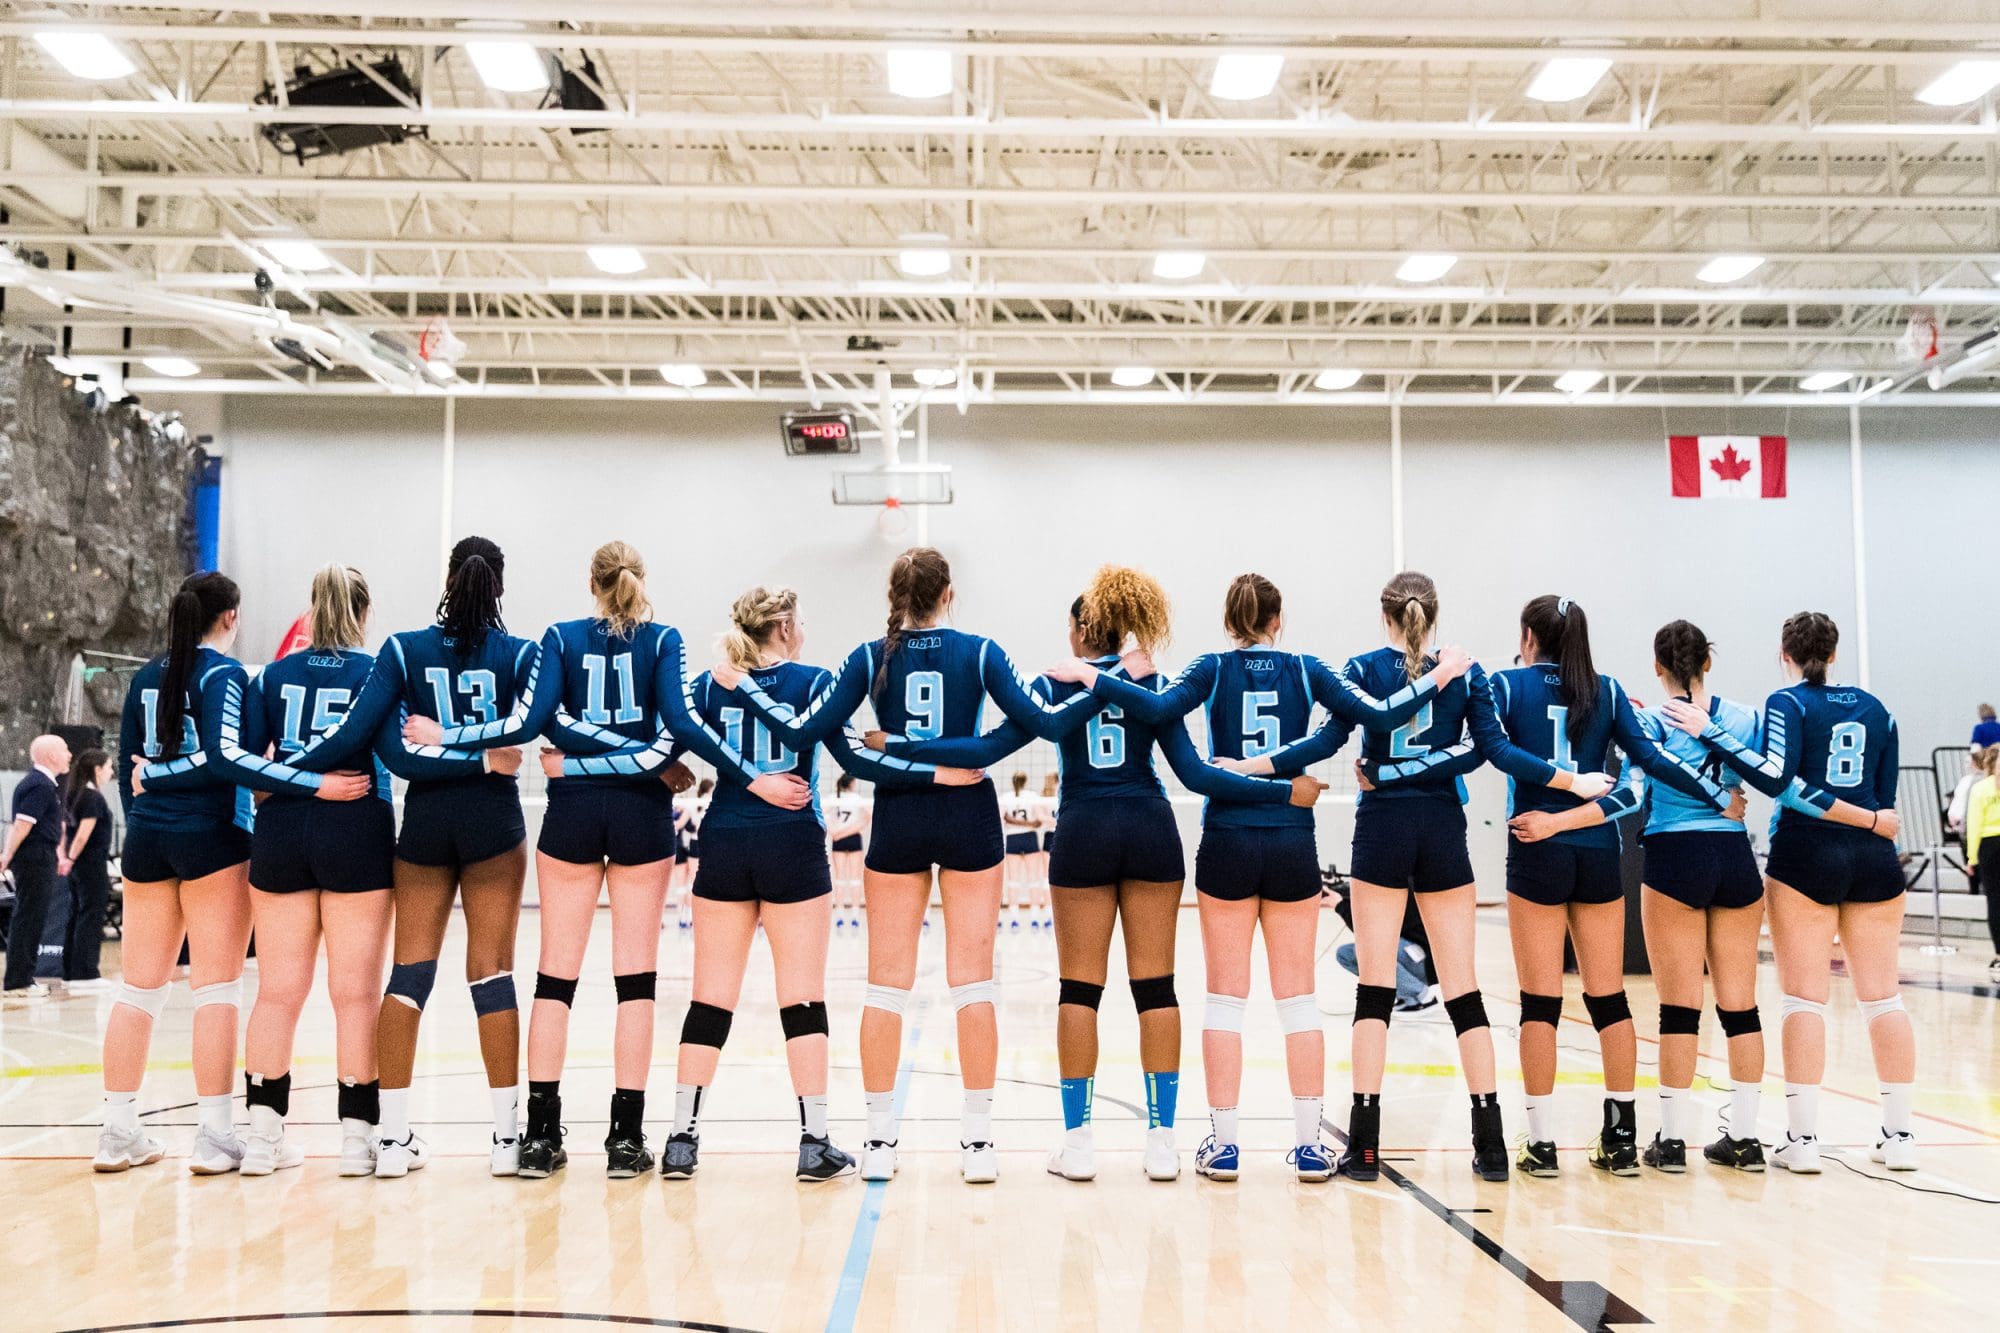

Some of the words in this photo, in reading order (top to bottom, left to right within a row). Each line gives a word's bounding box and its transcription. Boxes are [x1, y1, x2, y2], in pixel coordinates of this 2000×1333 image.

[801, 423, 846, 439] 4:00
[308, 656, 349, 669] OCAA
[582, 652, 643, 725] 11
[280, 683, 352, 754] 15
[425, 666, 498, 727] 13
[904, 671, 945, 741] 9
[1242, 690, 1281, 758] 5
[1085, 703, 1126, 769] 6
[1547, 704, 1579, 774] 1
[1825, 721, 1867, 788] 8
